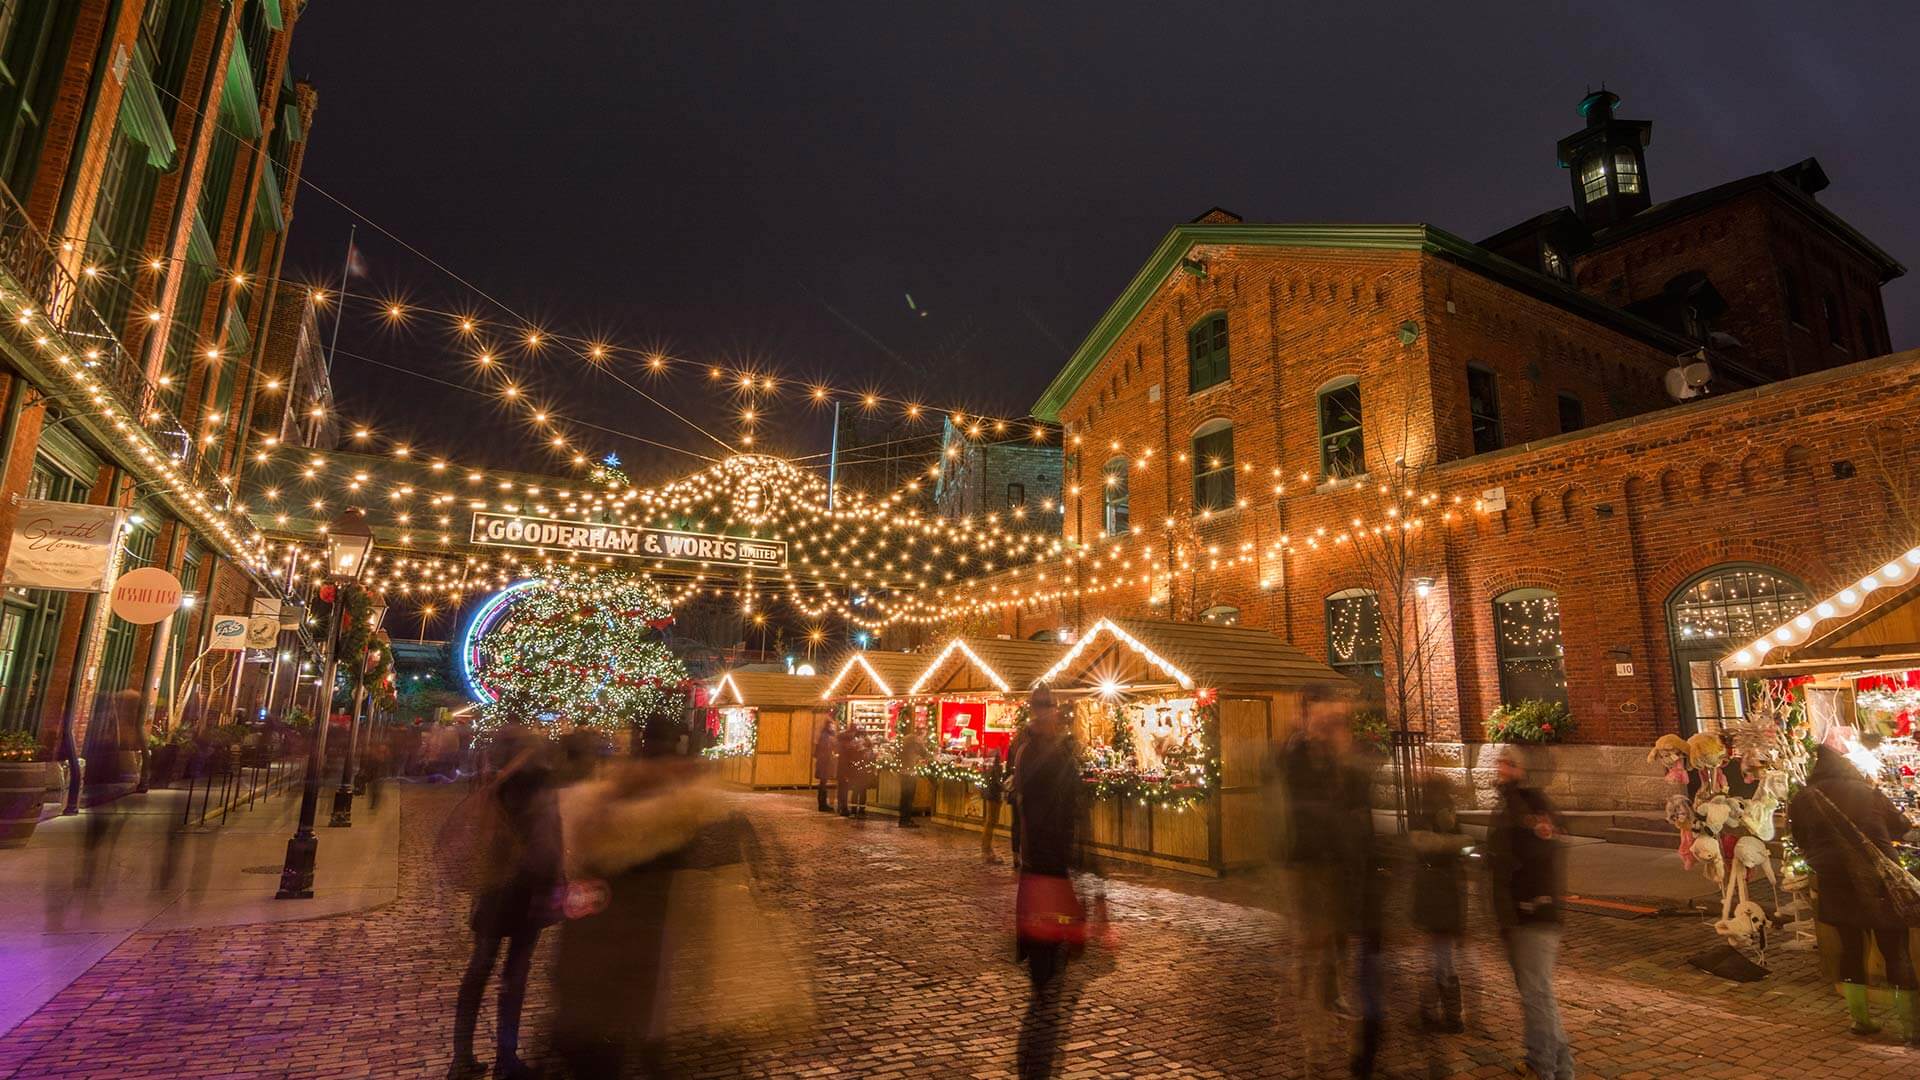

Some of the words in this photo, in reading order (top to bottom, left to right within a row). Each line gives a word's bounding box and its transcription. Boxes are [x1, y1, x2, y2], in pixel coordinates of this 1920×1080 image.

[487, 519, 638, 551] GOODERHAM
[644, 534, 663, 553] &
[664, 535, 737, 560] WORTS
[739, 545, 777, 560] LIMITED
